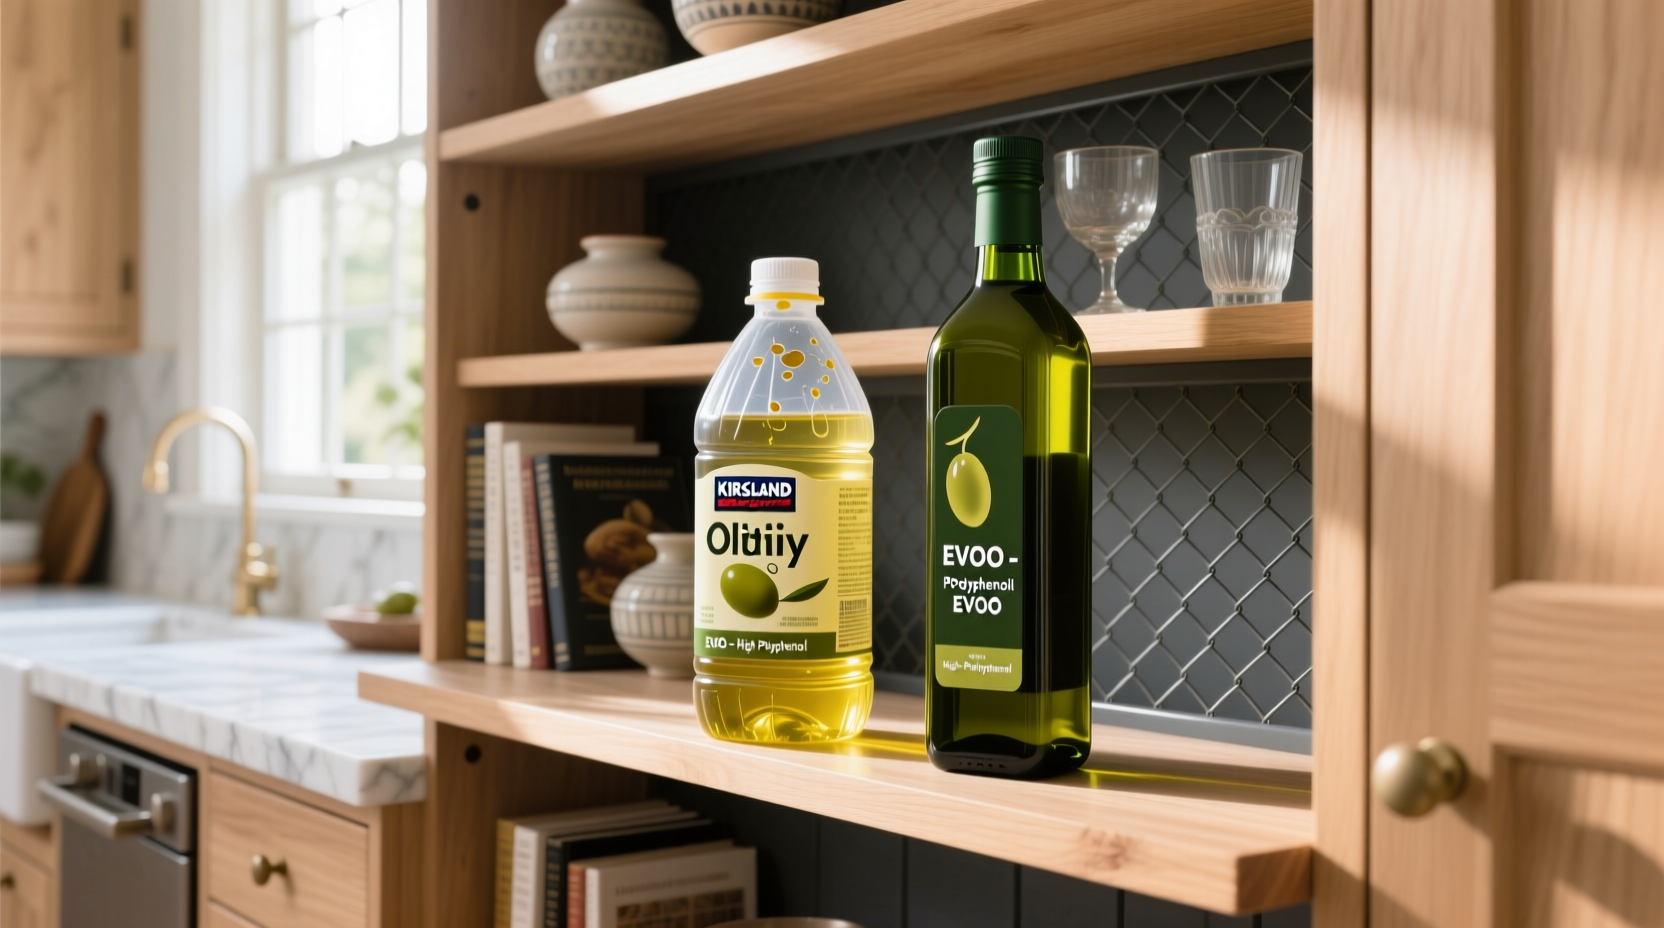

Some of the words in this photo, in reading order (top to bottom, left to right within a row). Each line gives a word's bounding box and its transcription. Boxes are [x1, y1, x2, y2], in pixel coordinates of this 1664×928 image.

[718, 481, 792, 497] KIRSLAND
[943, 544, 1004, 568] EVOO
[953, 595, 1002, 615] EVOO
